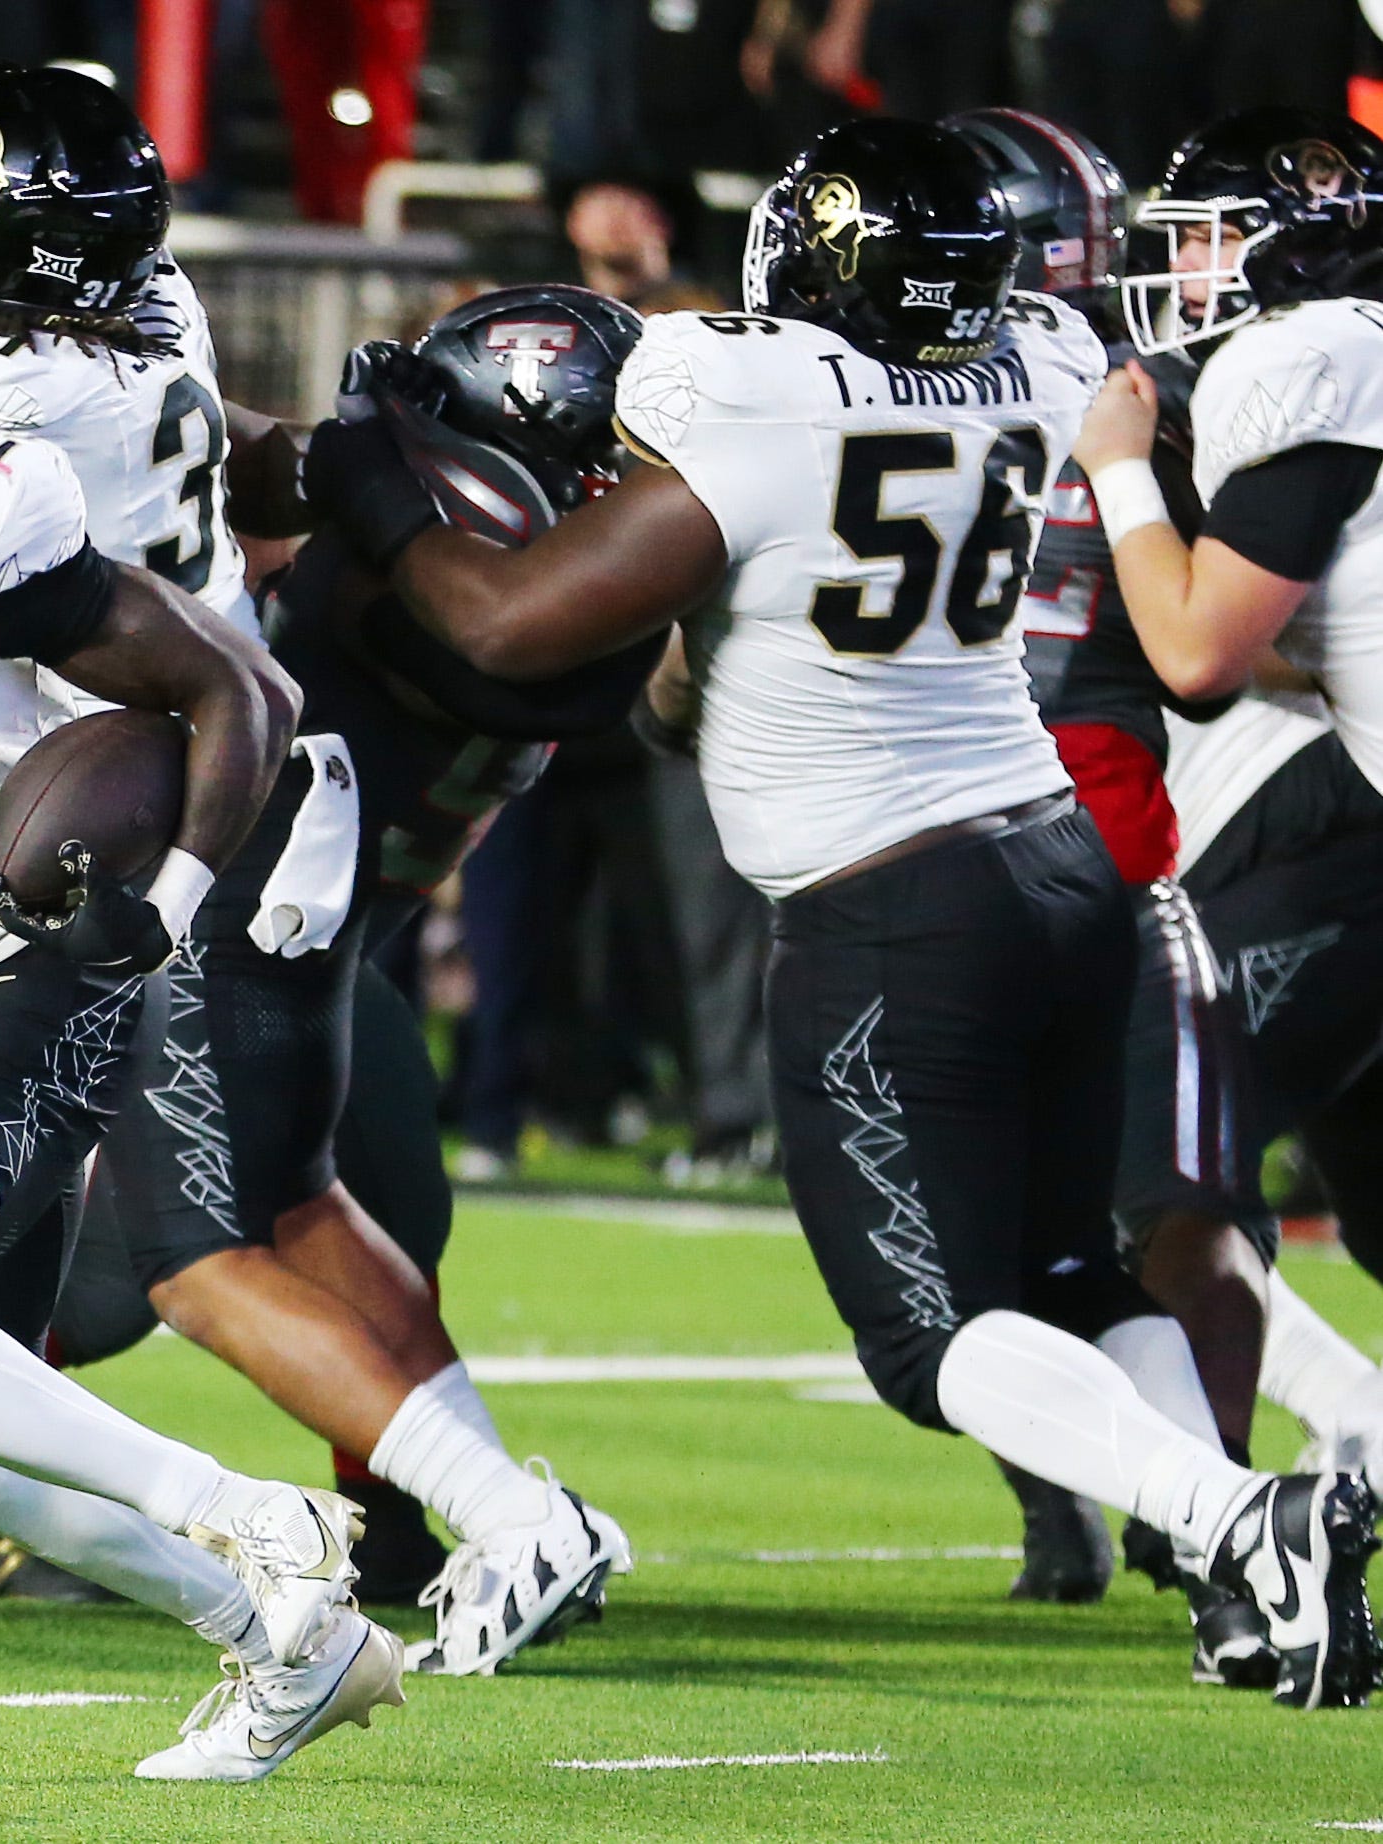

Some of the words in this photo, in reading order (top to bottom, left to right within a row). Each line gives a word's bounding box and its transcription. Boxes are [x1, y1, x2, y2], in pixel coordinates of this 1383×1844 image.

[73, 280, 121, 309] 31
[944, 307, 991, 339] 56
[818, 354, 874, 408] T.
[881, 348, 1032, 406] BROWN
[807, 427, 1048, 656] 56
